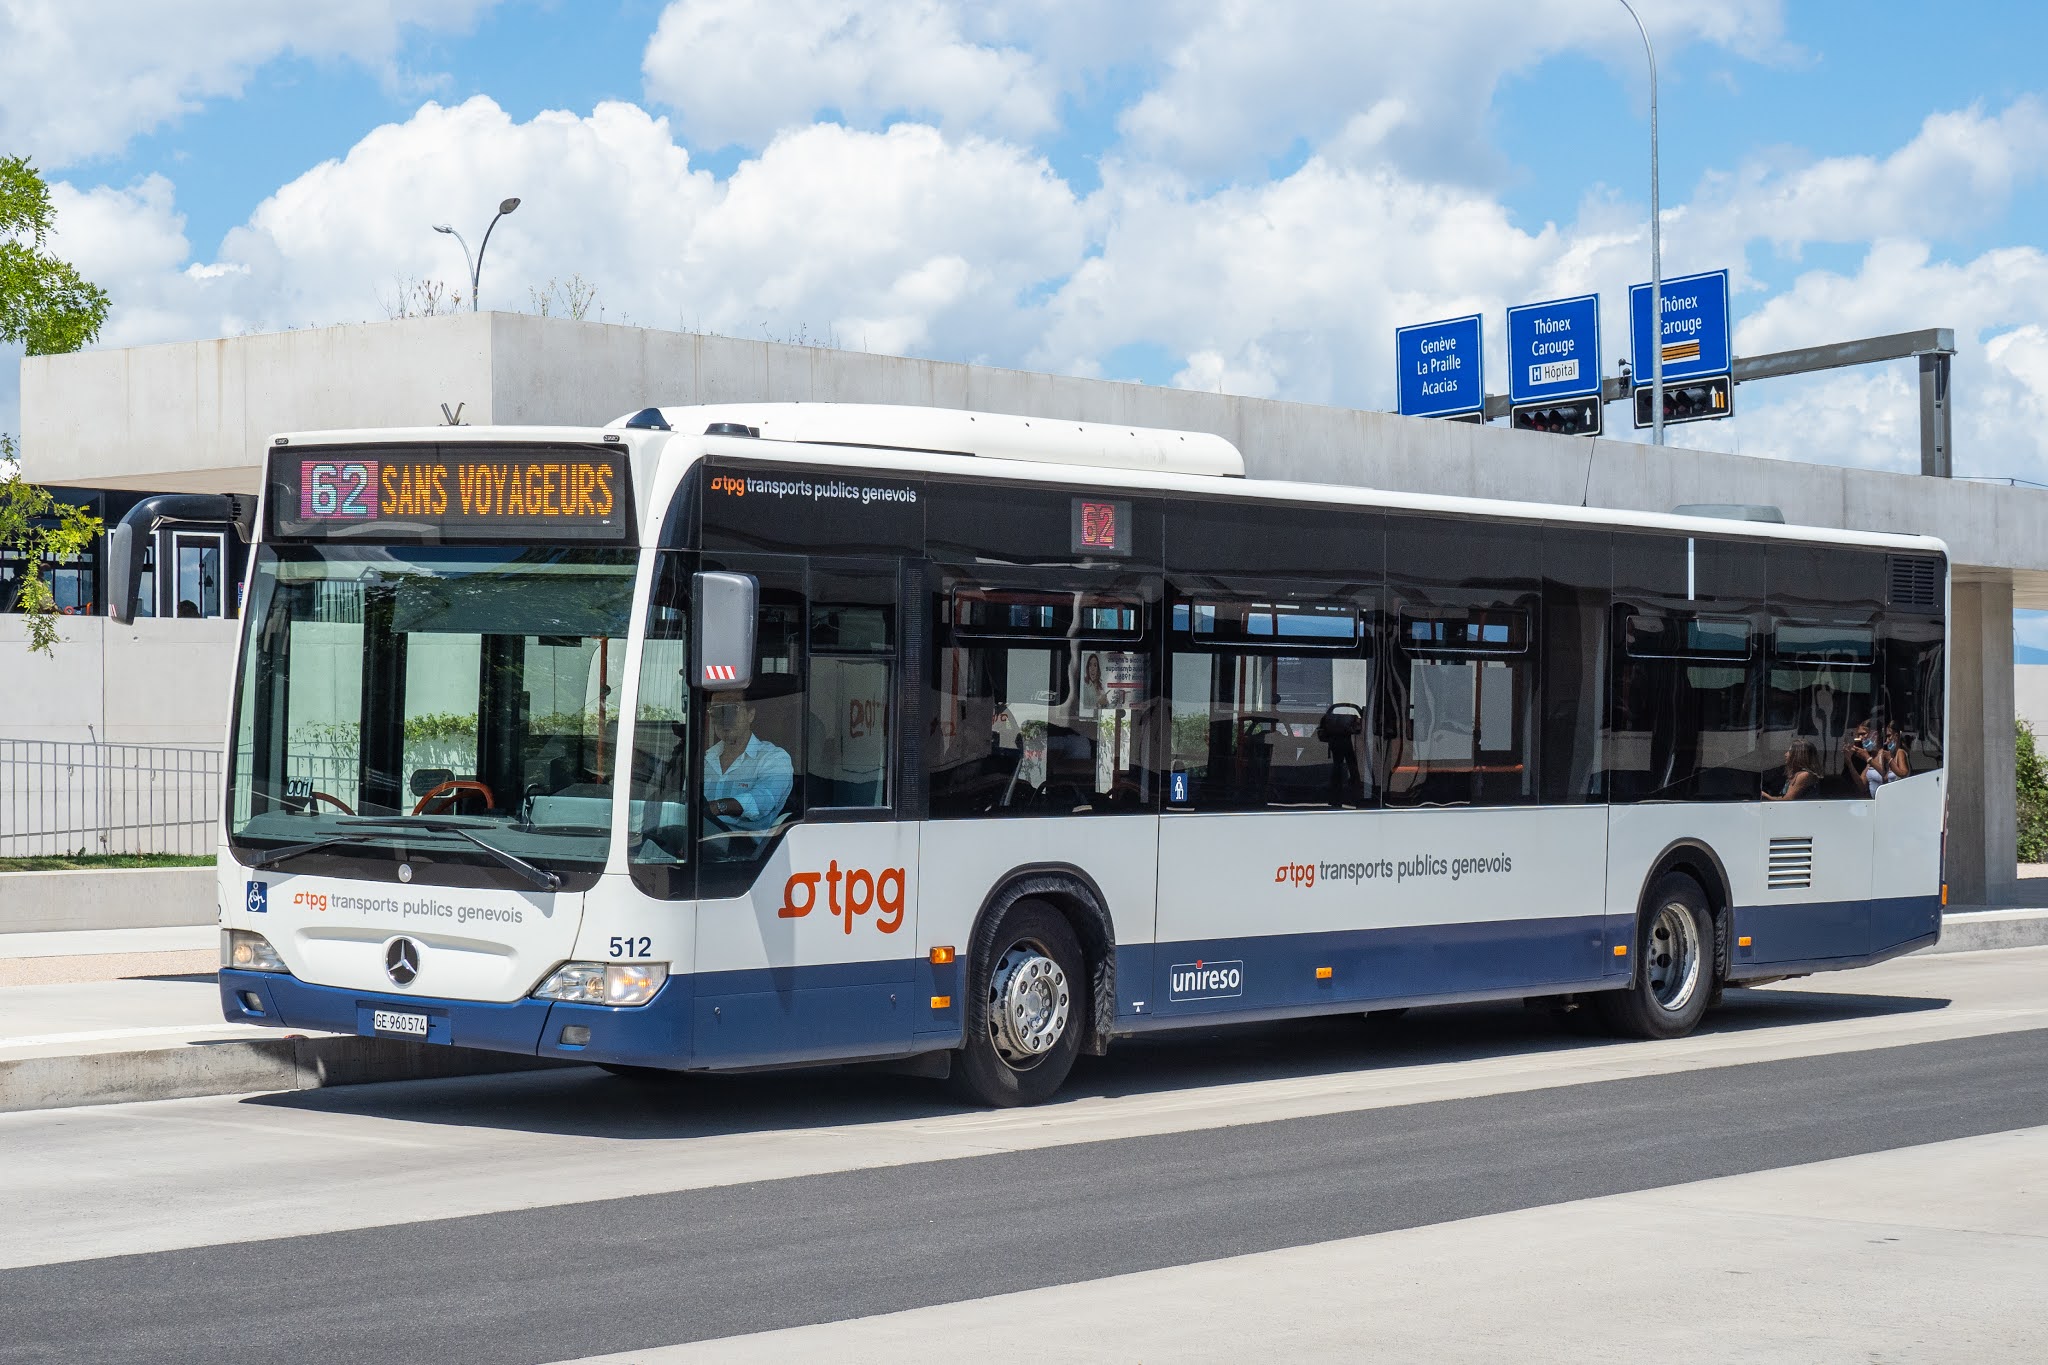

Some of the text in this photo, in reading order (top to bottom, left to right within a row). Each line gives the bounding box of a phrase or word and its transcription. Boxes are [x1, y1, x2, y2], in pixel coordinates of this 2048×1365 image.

[1534, 317, 1571, 334] Thônex
[1660, 317, 1702, 335] arouge
[1420, 336, 1457, 355] Genève
[1531, 338, 1575, 357] Carouge
[1417, 355, 1461, 376] La Praille
[1544, 363, 1577, 380] Hôpital
[1421, 377, 1458, 396] Acacias
[311, 464, 613, 515] 62 SANS VOYAGEURS
[746, 477, 813, 498] transports
[814, 482, 860, 501] publics
[861, 484, 917, 505] genevois
[1083, 506, 1113, 543] 62
[1319, 858, 1393, 886] transports
[1397, 854, 1448, 884] publics
[1451, 852, 1512, 881] genevois
[331, 894, 399, 917] transports
[402, 898, 453, 920] publics
[457, 904, 523, 924] genevois
[608, 936, 652, 958] 512
[1172, 968, 1240, 993] unireso
